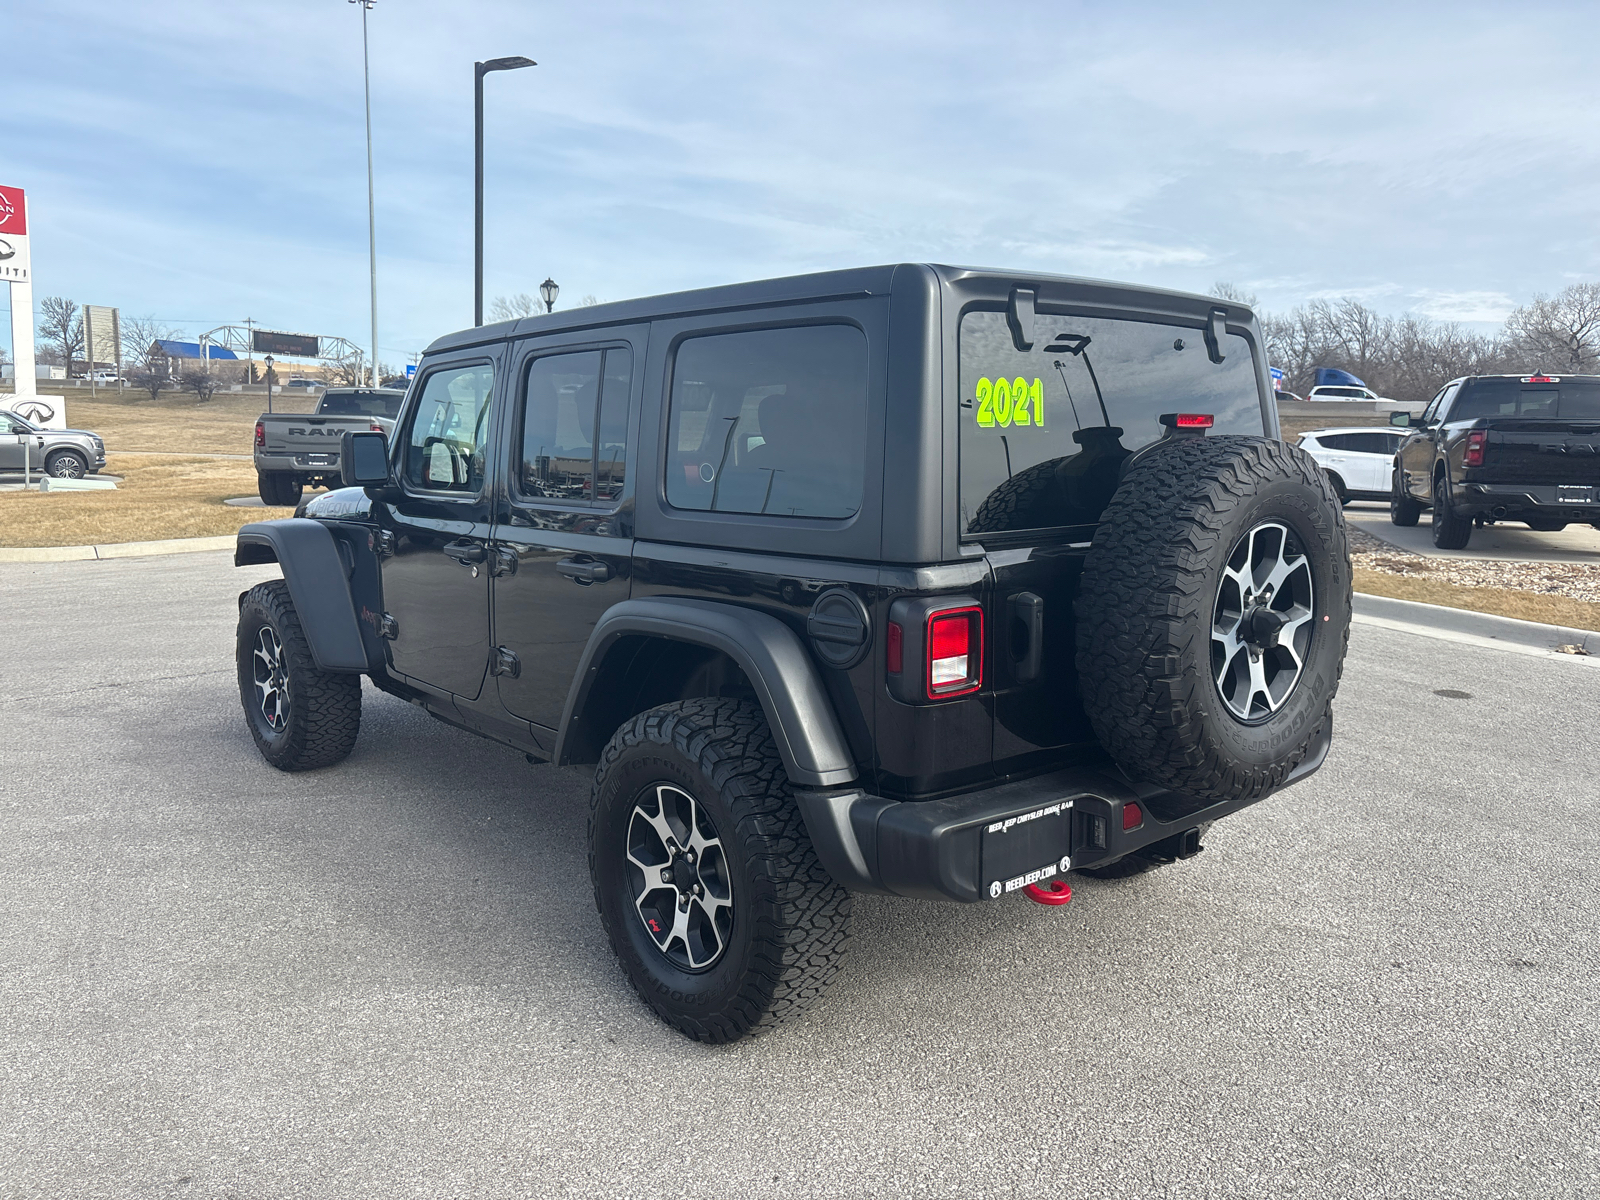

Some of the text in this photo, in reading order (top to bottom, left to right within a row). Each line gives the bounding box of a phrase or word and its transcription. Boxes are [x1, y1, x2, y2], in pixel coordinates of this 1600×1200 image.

[976, 376, 1045, 428] 2021
[288, 427, 346, 436] RAM
[989, 801, 1073, 833] REED JEEP CHRYSLER DODGE RAM
[1006, 865, 1057, 892] REEDJEEP.COM
